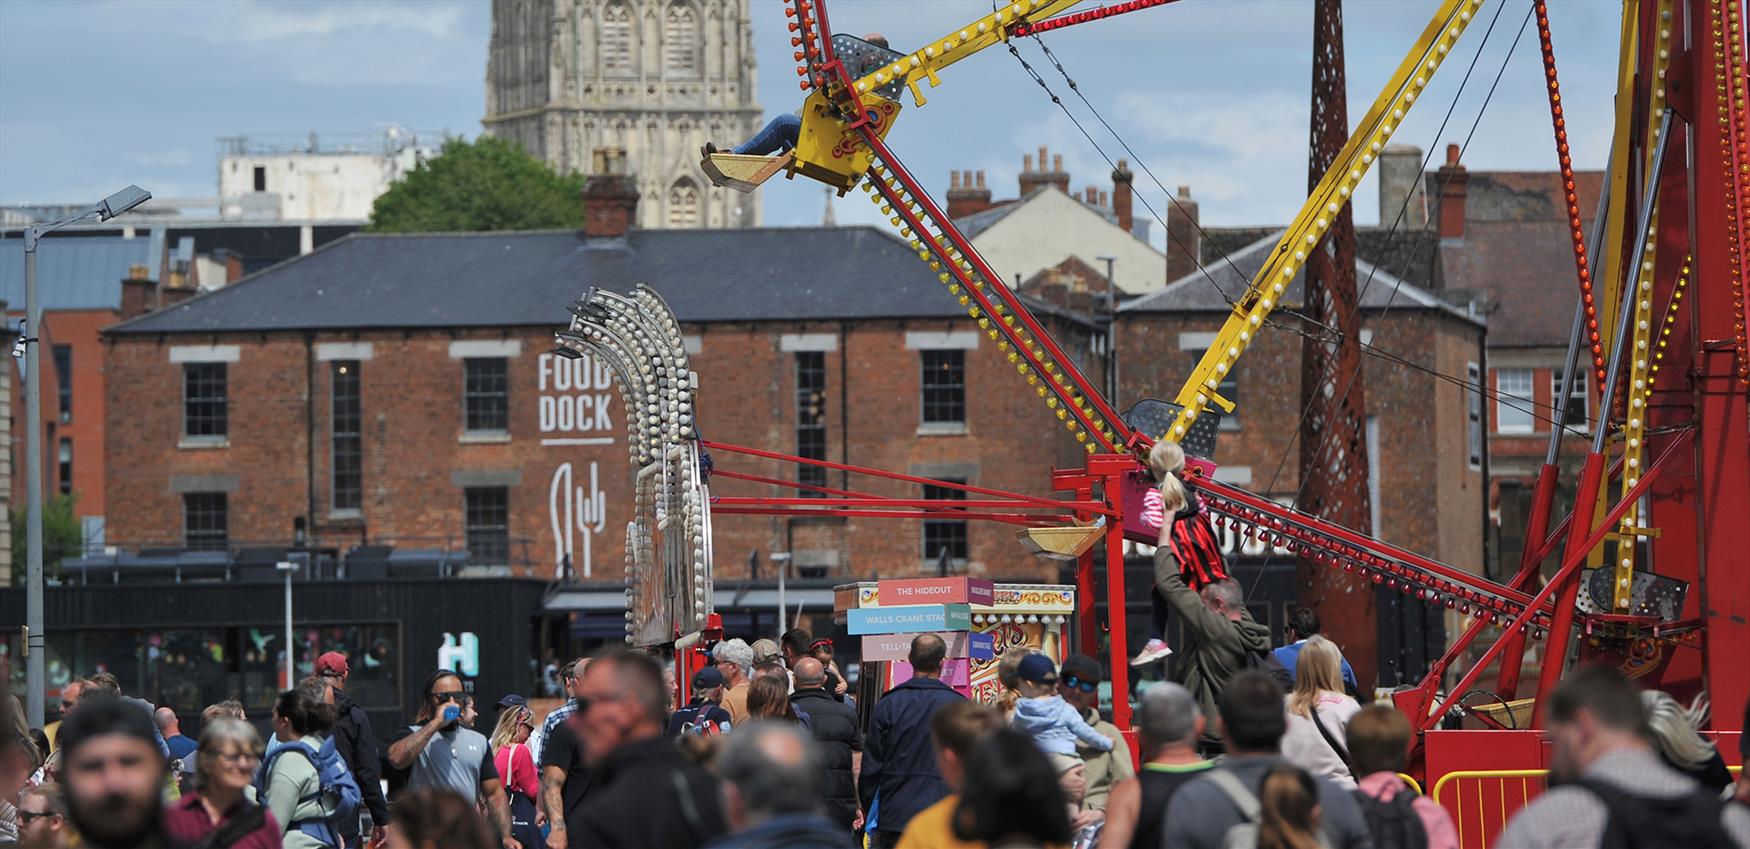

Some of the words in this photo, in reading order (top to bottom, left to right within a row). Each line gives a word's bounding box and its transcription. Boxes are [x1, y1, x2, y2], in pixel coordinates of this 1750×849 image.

[538, 352, 612, 391] FOOD
[539, 394, 613, 432] DOCK
[896, 587, 913, 596] THE
[915, 586, 952, 595] HIDEOUT
[866, 615, 894, 624] WALLS
[895, 614, 925, 623] CRANE
[926, 614, 945, 622] STAG
[880, 642, 912, 651] TELL-TA
